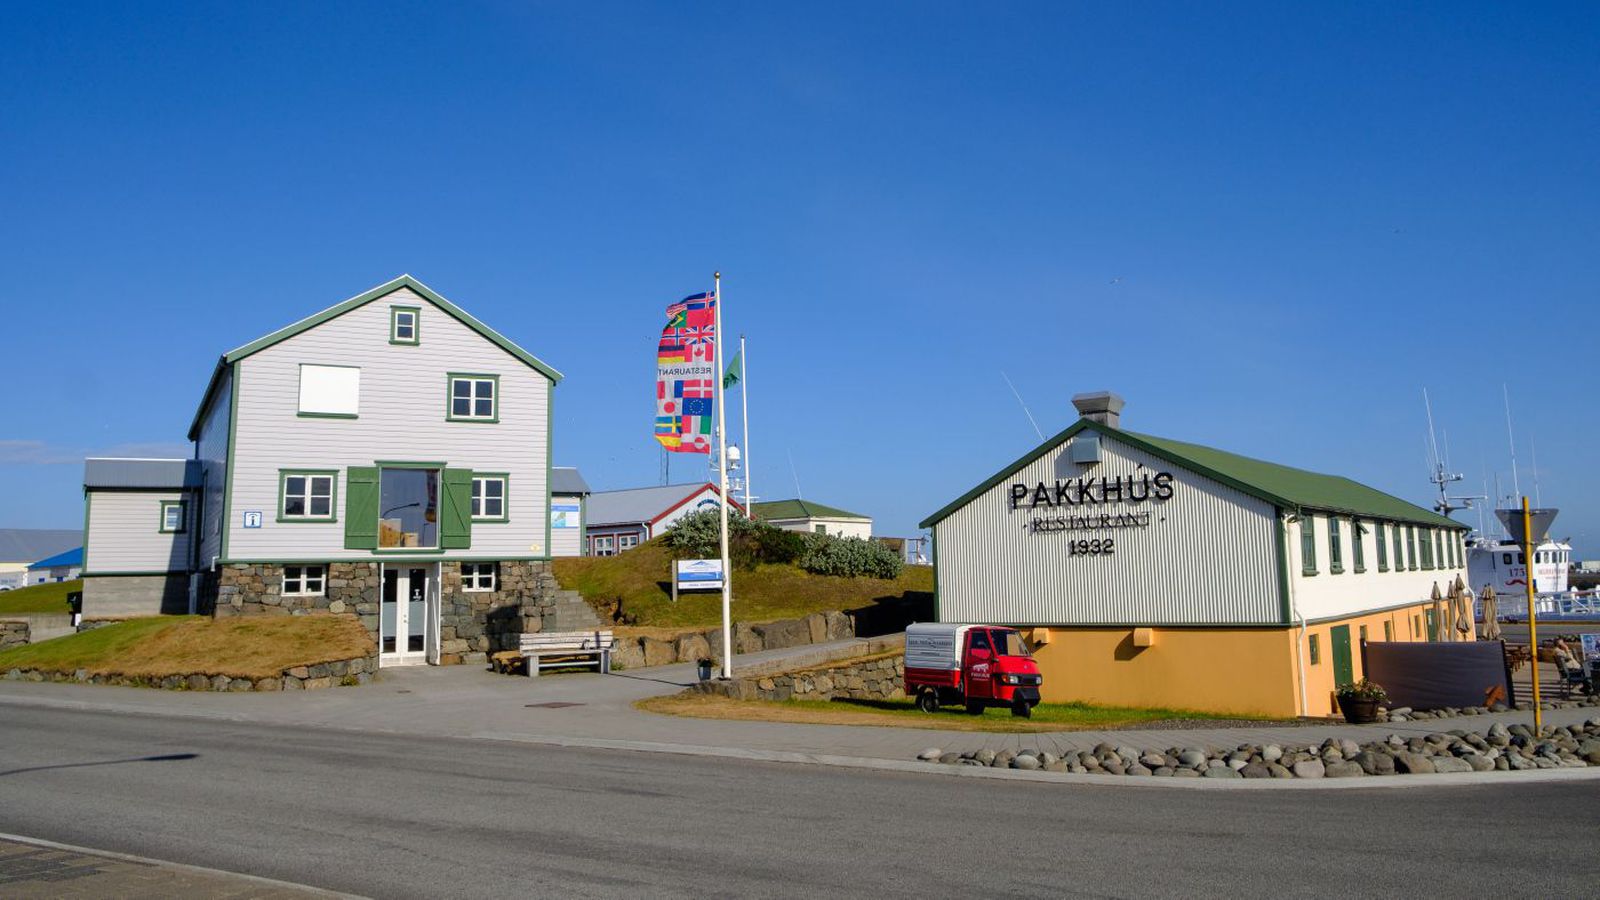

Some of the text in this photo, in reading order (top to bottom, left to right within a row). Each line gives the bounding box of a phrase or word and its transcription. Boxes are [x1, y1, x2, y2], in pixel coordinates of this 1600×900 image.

[1011, 464, 1174, 510] PAKKHÚS
[1033, 511, 1151, 532] RESTAURANT
[1070, 538, 1115, 555] 1932
